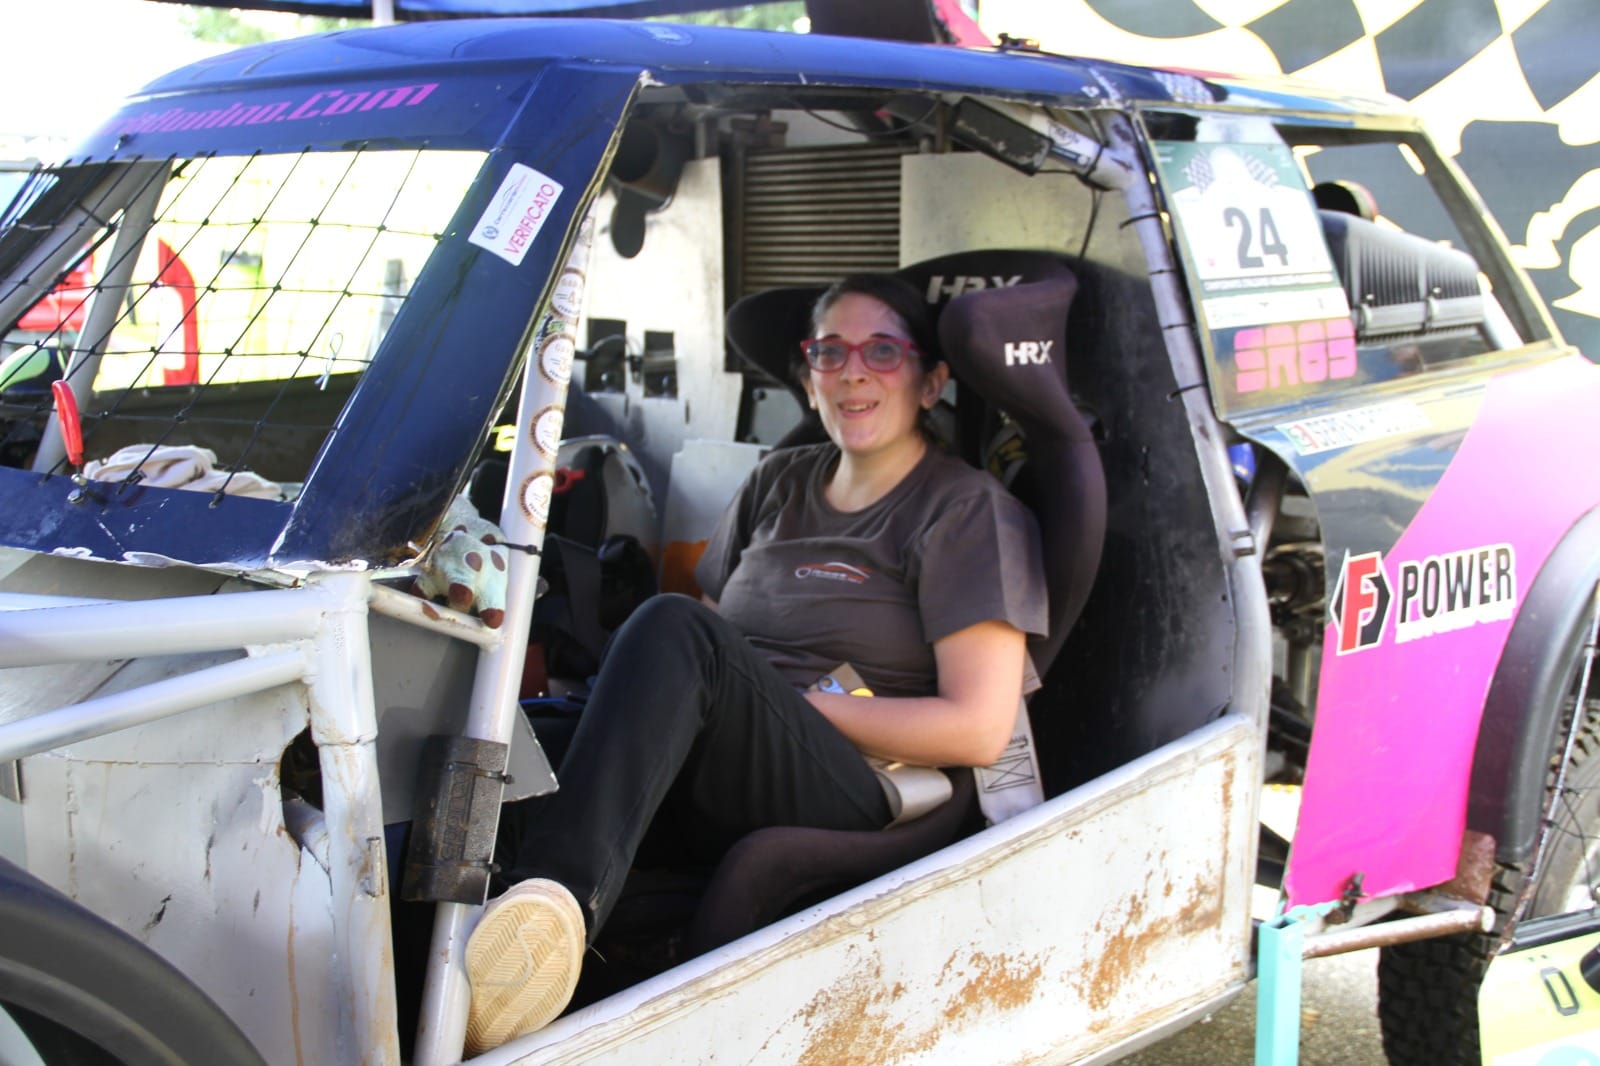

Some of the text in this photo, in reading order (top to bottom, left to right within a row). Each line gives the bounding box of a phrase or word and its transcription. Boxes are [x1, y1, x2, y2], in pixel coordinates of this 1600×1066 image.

[504, 183, 556, 254] VERIFICATO
[1223, 206, 1289, 269] 24
[1004, 340, 1053, 367] HRX
[1400, 547, 1512, 624] POWER
